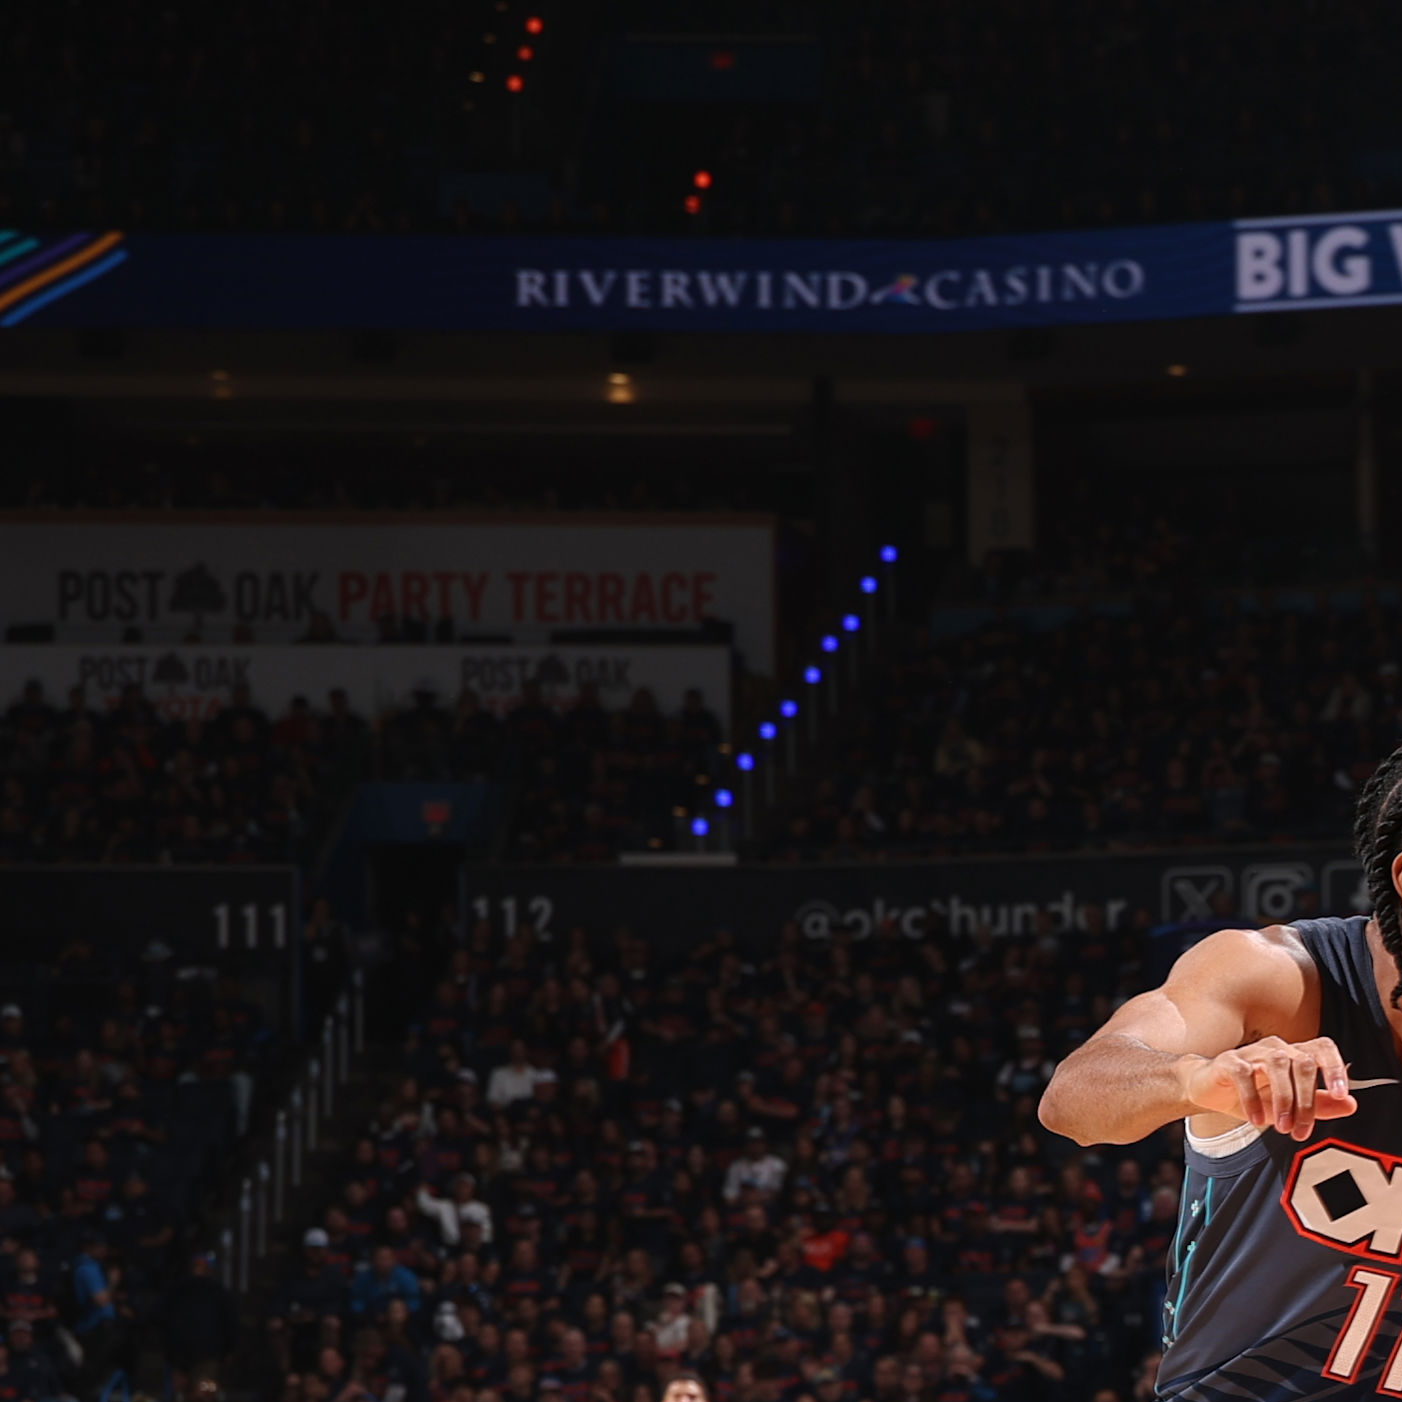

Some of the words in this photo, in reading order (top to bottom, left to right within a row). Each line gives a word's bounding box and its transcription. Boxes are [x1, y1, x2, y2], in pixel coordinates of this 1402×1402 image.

[514, 268, 868, 310] RIVERWIND
[924, 259, 1145, 309] CASINO
[1233, 226, 1372, 302] BIG
[58, 571, 166, 621] POST
[234, 571, 321, 621] OAK
[338, 569, 490, 622] PARTY
[507, 569, 718, 622] TERRACE
[79, 656, 149, 689] POST
[194, 656, 252, 688] OAK
[462, 656, 530, 691] POST
[576, 656, 631, 690] OAK
[213, 901, 289, 949] 111
